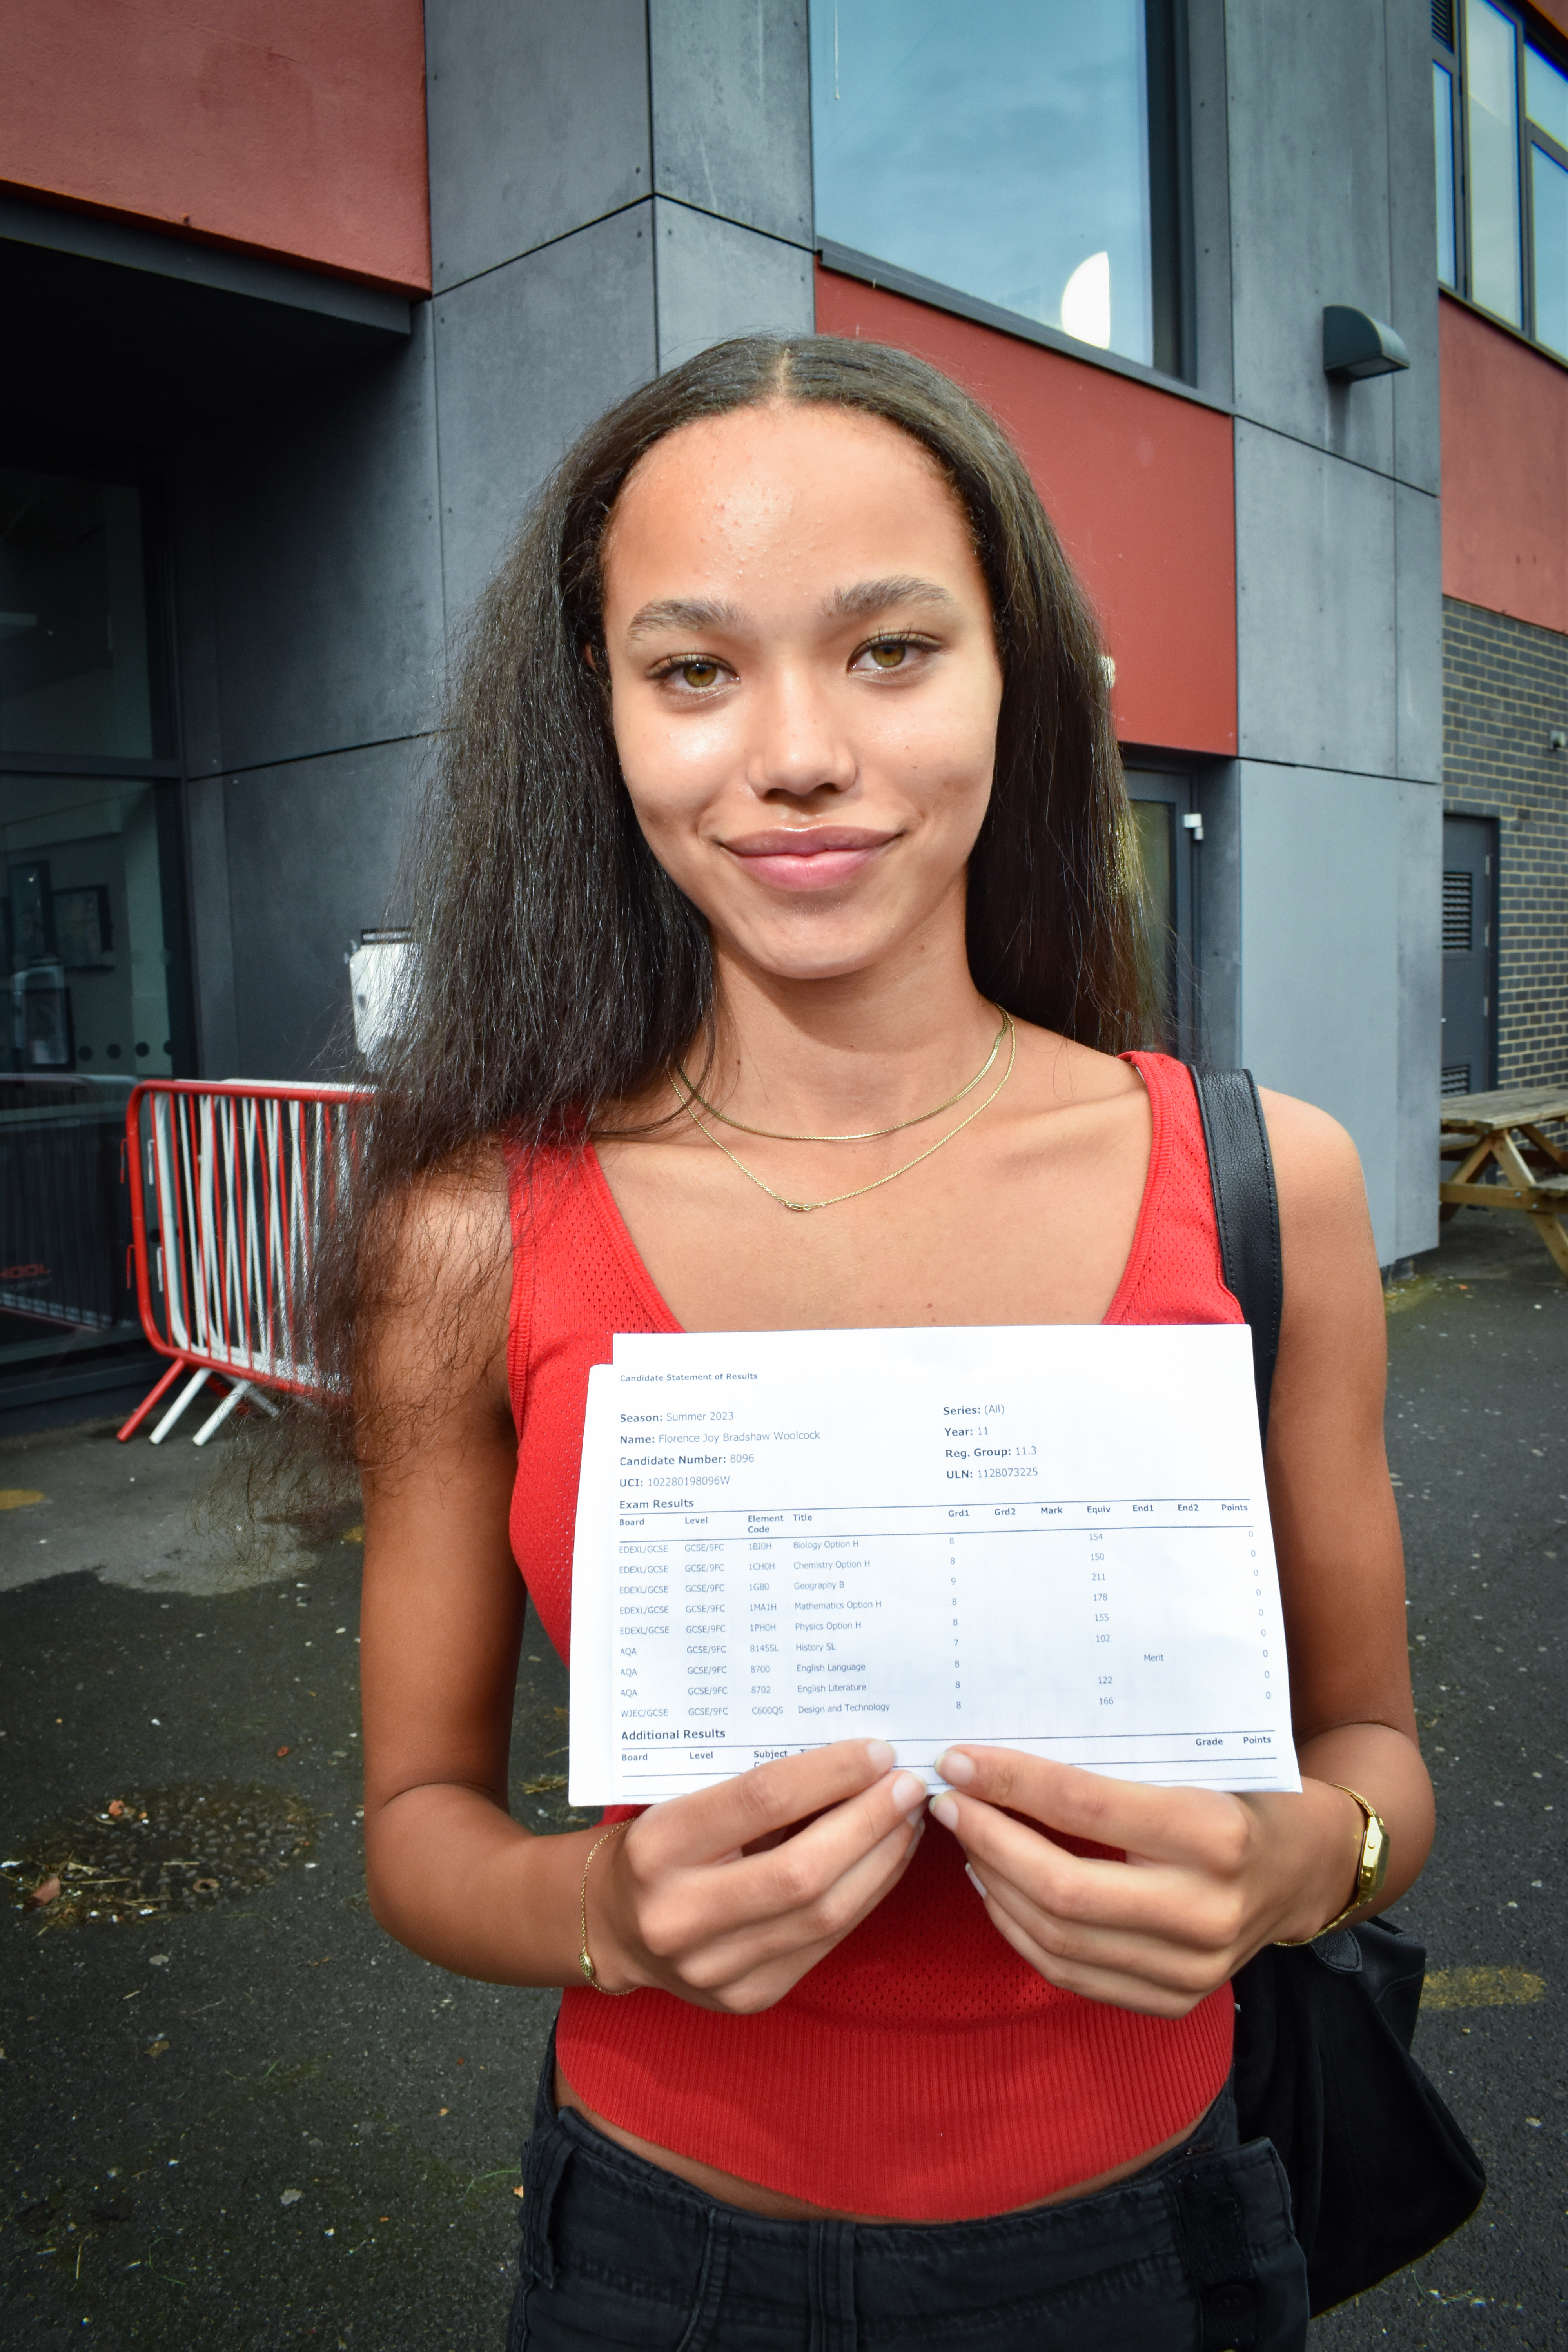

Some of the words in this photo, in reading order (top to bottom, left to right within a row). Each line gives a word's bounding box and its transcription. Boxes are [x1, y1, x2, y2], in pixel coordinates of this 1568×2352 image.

[620, 1374, 664, 1382] Candidate
[666, 1373, 713, 1381] Statement
[714, 1372, 724, 1381] of
[726, 1372, 759, 1380] Results
[942, 1405, 981, 1416] Series:
[984, 1403, 1005, 1416] (All)
[620, 1414, 663, 1423] Season:
[666, 1412, 707, 1422] Summer
[710, 1411, 734, 1421] 2023
[943, 1427, 973, 1437] Year:
[978, 1426, 989, 1436] 11
[619, 1435, 655, 1445] Name:
[659, 1434, 700, 1443] Florence
[702, 1433, 720, 1445] Joy
[722, 1431, 771, 1442] Bradshaw
[773, 1430, 821, 1441] Woolcock
[945, 1449, 971, 1460] Reg.
[973, 1447, 1012, 1459] Group:
[1015, 1445, 1037, 1456] 11.3
[619, 1455, 675, 1466] Candidate
[678, 1454, 726, 1465] Number:
[730, 1453, 755, 1464] 8096
[946, 1469, 973, 1479] ULN:
[977, 1467, 1038, 1479] 1128073225
[619, 1477, 644, 1488] UCI:
[648, 1475, 731, 1487] 102280198096W
[619, 1500, 650, 1510] Exam
[652, 1498, 695, 1509] Results
[1132, 1504, 1155, 1512] End1
[1177, 1503, 1200, 1512] End2
[1221, 1503, 1249, 1512] Points
[947, 1509, 970, 1518] Grd1
[994, 1507, 1017, 1516] Grd2
[1040, 1506, 1063, 1515] Mark
[1086, 1505, 1111, 1515] Equiv
[619, 1517, 645, 1526] Board
[684, 1515, 708, 1525] Level
[747, 1514, 784, 1523] Element
[792, 1513, 813, 1522] Title
[747, 1525, 770, 1534] Code
[1248, 1530, 1254, 1538] 0
[949, 1537, 955, 1545] 8
[1089, 1532, 1103, 1541] 154
[619, 1544, 669, 1555] EDEXL/GCSE
[684, 1543, 725, 1553] GCSE/9FC
[793, 1541, 822, 1551] Biology
[824, 1540, 851, 1550] Option
[852, 1539, 859, 1548] H
[1091, 1552, 1105, 1561] 150
[1250, 1549, 1256, 1557] 0
[793, 1561, 833, 1570] Chemistry
[835, 1560, 862, 1570] Option
[864, 1559, 871, 1568] H
[950, 1557, 956, 1565] 8
[619, 1564, 669, 1575] EDEXL/GCSE
[684, 1563, 725, 1573] GCSE/9FC
[1253, 1569, 1259, 1577] 0
[951, 1577, 956, 1586] 9
[1091, 1572, 1106, 1581] 211
[619, 1585, 669, 1595] EDEXL/GCSE
[685, 1583, 725, 1593] GCSE/9FC
[793, 1581, 837, 1592] Geography
[838, 1580, 845, 1589] B
[1093, 1592, 1108, 1602] 178
[1256, 1588, 1261, 1597] 0
[794, 1602, 844, 1611] Mathematics
[846, 1601, 873, 1611] Option
[951, 1597, 957, 1606] 8
[619, 1605, 669, 1615] EDEXL/GCSE
[685, 1604, 726, 1614] GCSE/9FC
[750, 1603, 777, 1612] 1MA1H
[1258, 1608, 1264, 1617] 0
[953, 1618, 958, 1627] 8
[1095, 1613, 1110, 1622] 155
[619, 1626, 670, 1636] EDEXL/GCSE
[685, 1624, 726, 1635] GCSE/9FC
[795, 1622, 824, 1632] Physics
[826, 1621, 853, 1632] Option
[855, 1621, 862, 1629] H
[1260, 1628, 1267, 1637] 0
[953, 1639, 959, 1647] 7
[1096, 1634, 1111, 1643] 102
[620, 1647, 637, 1657] AQA
[686, 1645, 727, 1655] GCSE/9FC
[750, 1644, 779, 1653] 8145SL
[795, 1643, 824, 1653] History
[826, 1642, 836, 1651] SL
[1143, 1653, 1164, 1662] Merit
[1262, 1649, 1269, 1658] 0
[796, 1664, 826, 1674] English
[827, 1663, 866, 1673] Language
[954, 1659, 960, 1668] 8
[620, 1668, 638, 1678] AQA
[687, 1665, 727, 1675] GCSE/9FC
[750, 1664, 771, 1674] 8700
[1264, 1670, 1270, 1679] 0
[955, 1680, 961, 1689] 8
[1098, 1675, 1113, 1685] 122
[621, 1688, 638, 1699] AQA
[687, 1686, 728, 1696] GCSE/9FC
[751, 1685, 771, 1694] 8702
[797, 1684, 826, 1695] English
[828, 1684, 867, 1692] Literature
[1265, 1691, 1272, 1700] 0
[956, 1700, 962, 1710] 8
[1099, 1696, 1114, 1706] 166
[621, 1708, 669, 1719] WJEC/GCSE
[688, 1707, 729, 1717] GCSE/9FC
[751, 1706, 784, 1716] C600QS
[797, 1705, 825, 1715] Design
[845, 1703, 890, 1712] Technology
[621, 1729, 679, 1741] Additional
[683, 1728, 726, 1739] Results
[1195, 1737, 1224, 1747] Grade
[1242, 1735, 1272, 1745] Points
[621, 1752, 648, 1762] Board
[689, 1750, 713, 1760] Level
[753, 1749, 788, 1760] Subject
